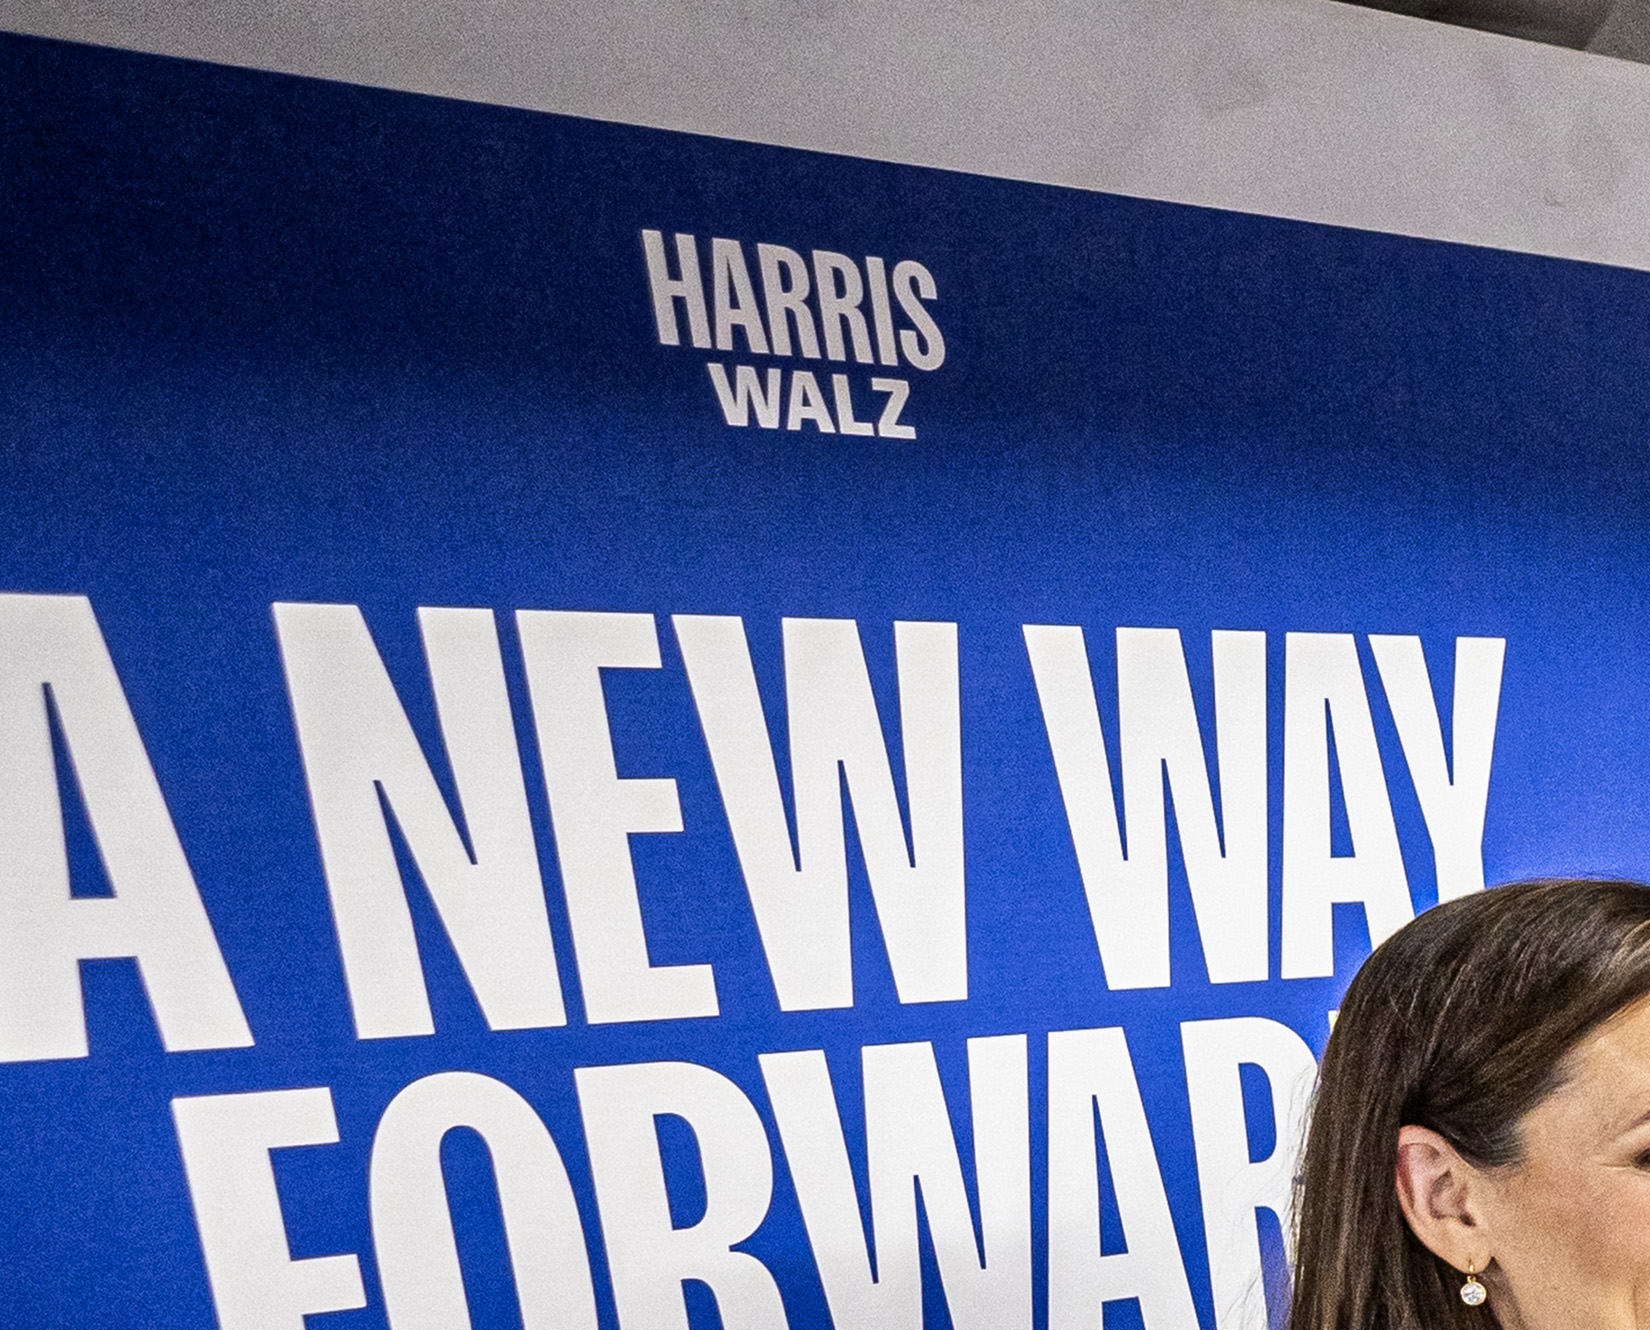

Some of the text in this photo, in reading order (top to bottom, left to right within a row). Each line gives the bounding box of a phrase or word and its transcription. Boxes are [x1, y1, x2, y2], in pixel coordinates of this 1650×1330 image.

[641, 229, 946, 372] HARRIS
[707, 362, 918, 440] WALZ
[0, 592, 1505, 1063] A NEW WAY
